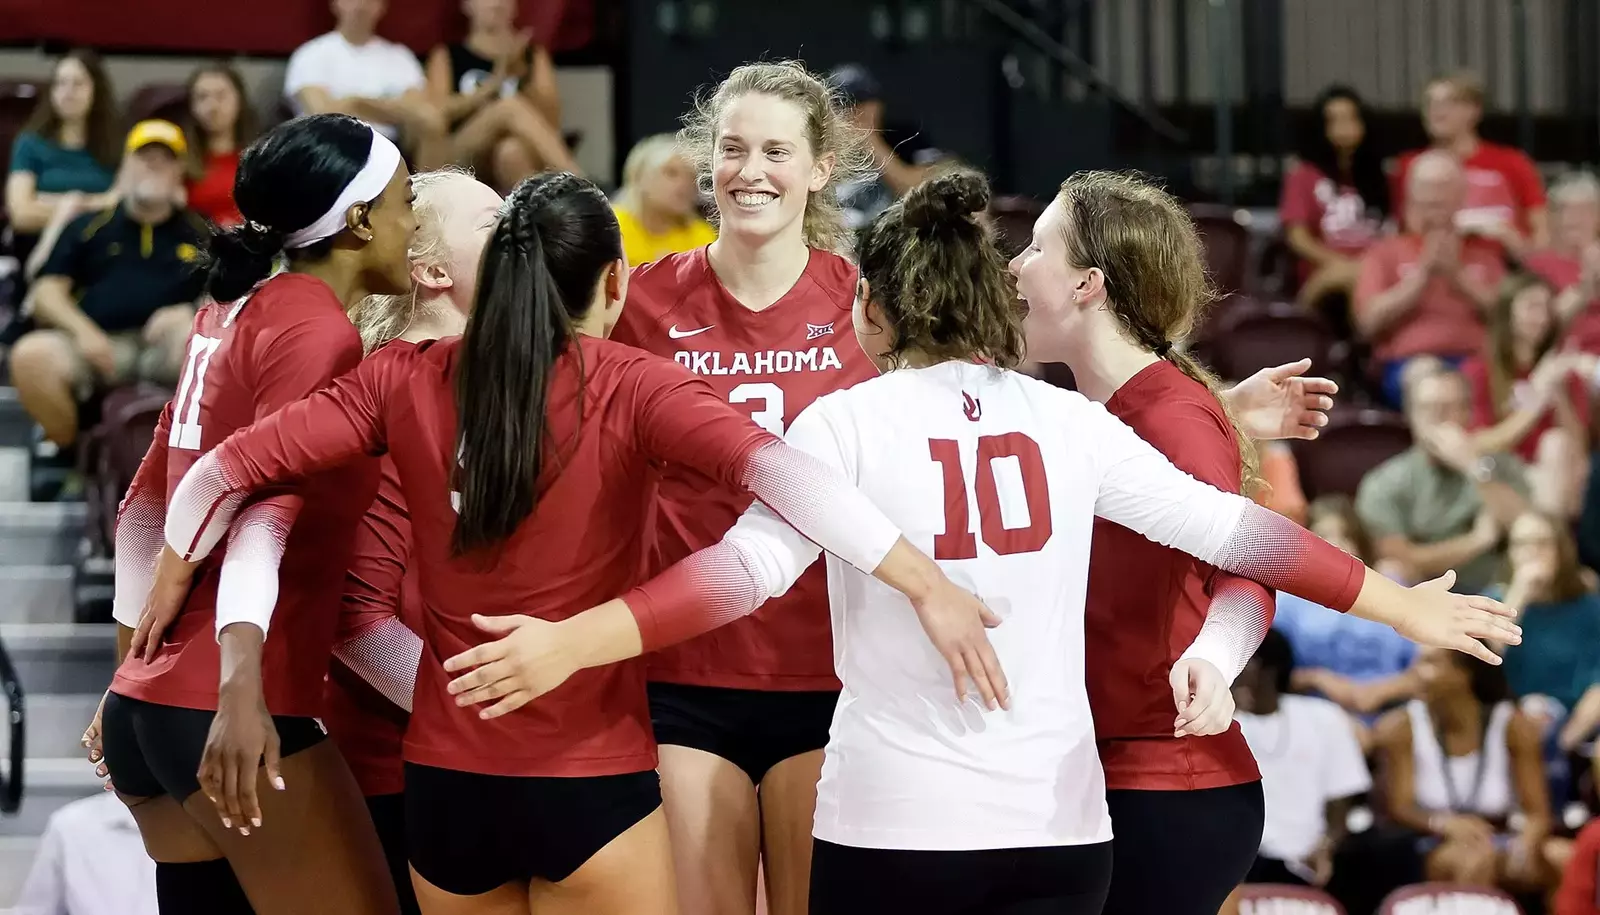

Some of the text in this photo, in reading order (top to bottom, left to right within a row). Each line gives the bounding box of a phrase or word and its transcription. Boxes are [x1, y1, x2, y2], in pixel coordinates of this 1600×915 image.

[168, 333, 223, 451] 11
[674, 347, 842, 375] OKLAHOMA
[928, 431, 1053, 560] 10
